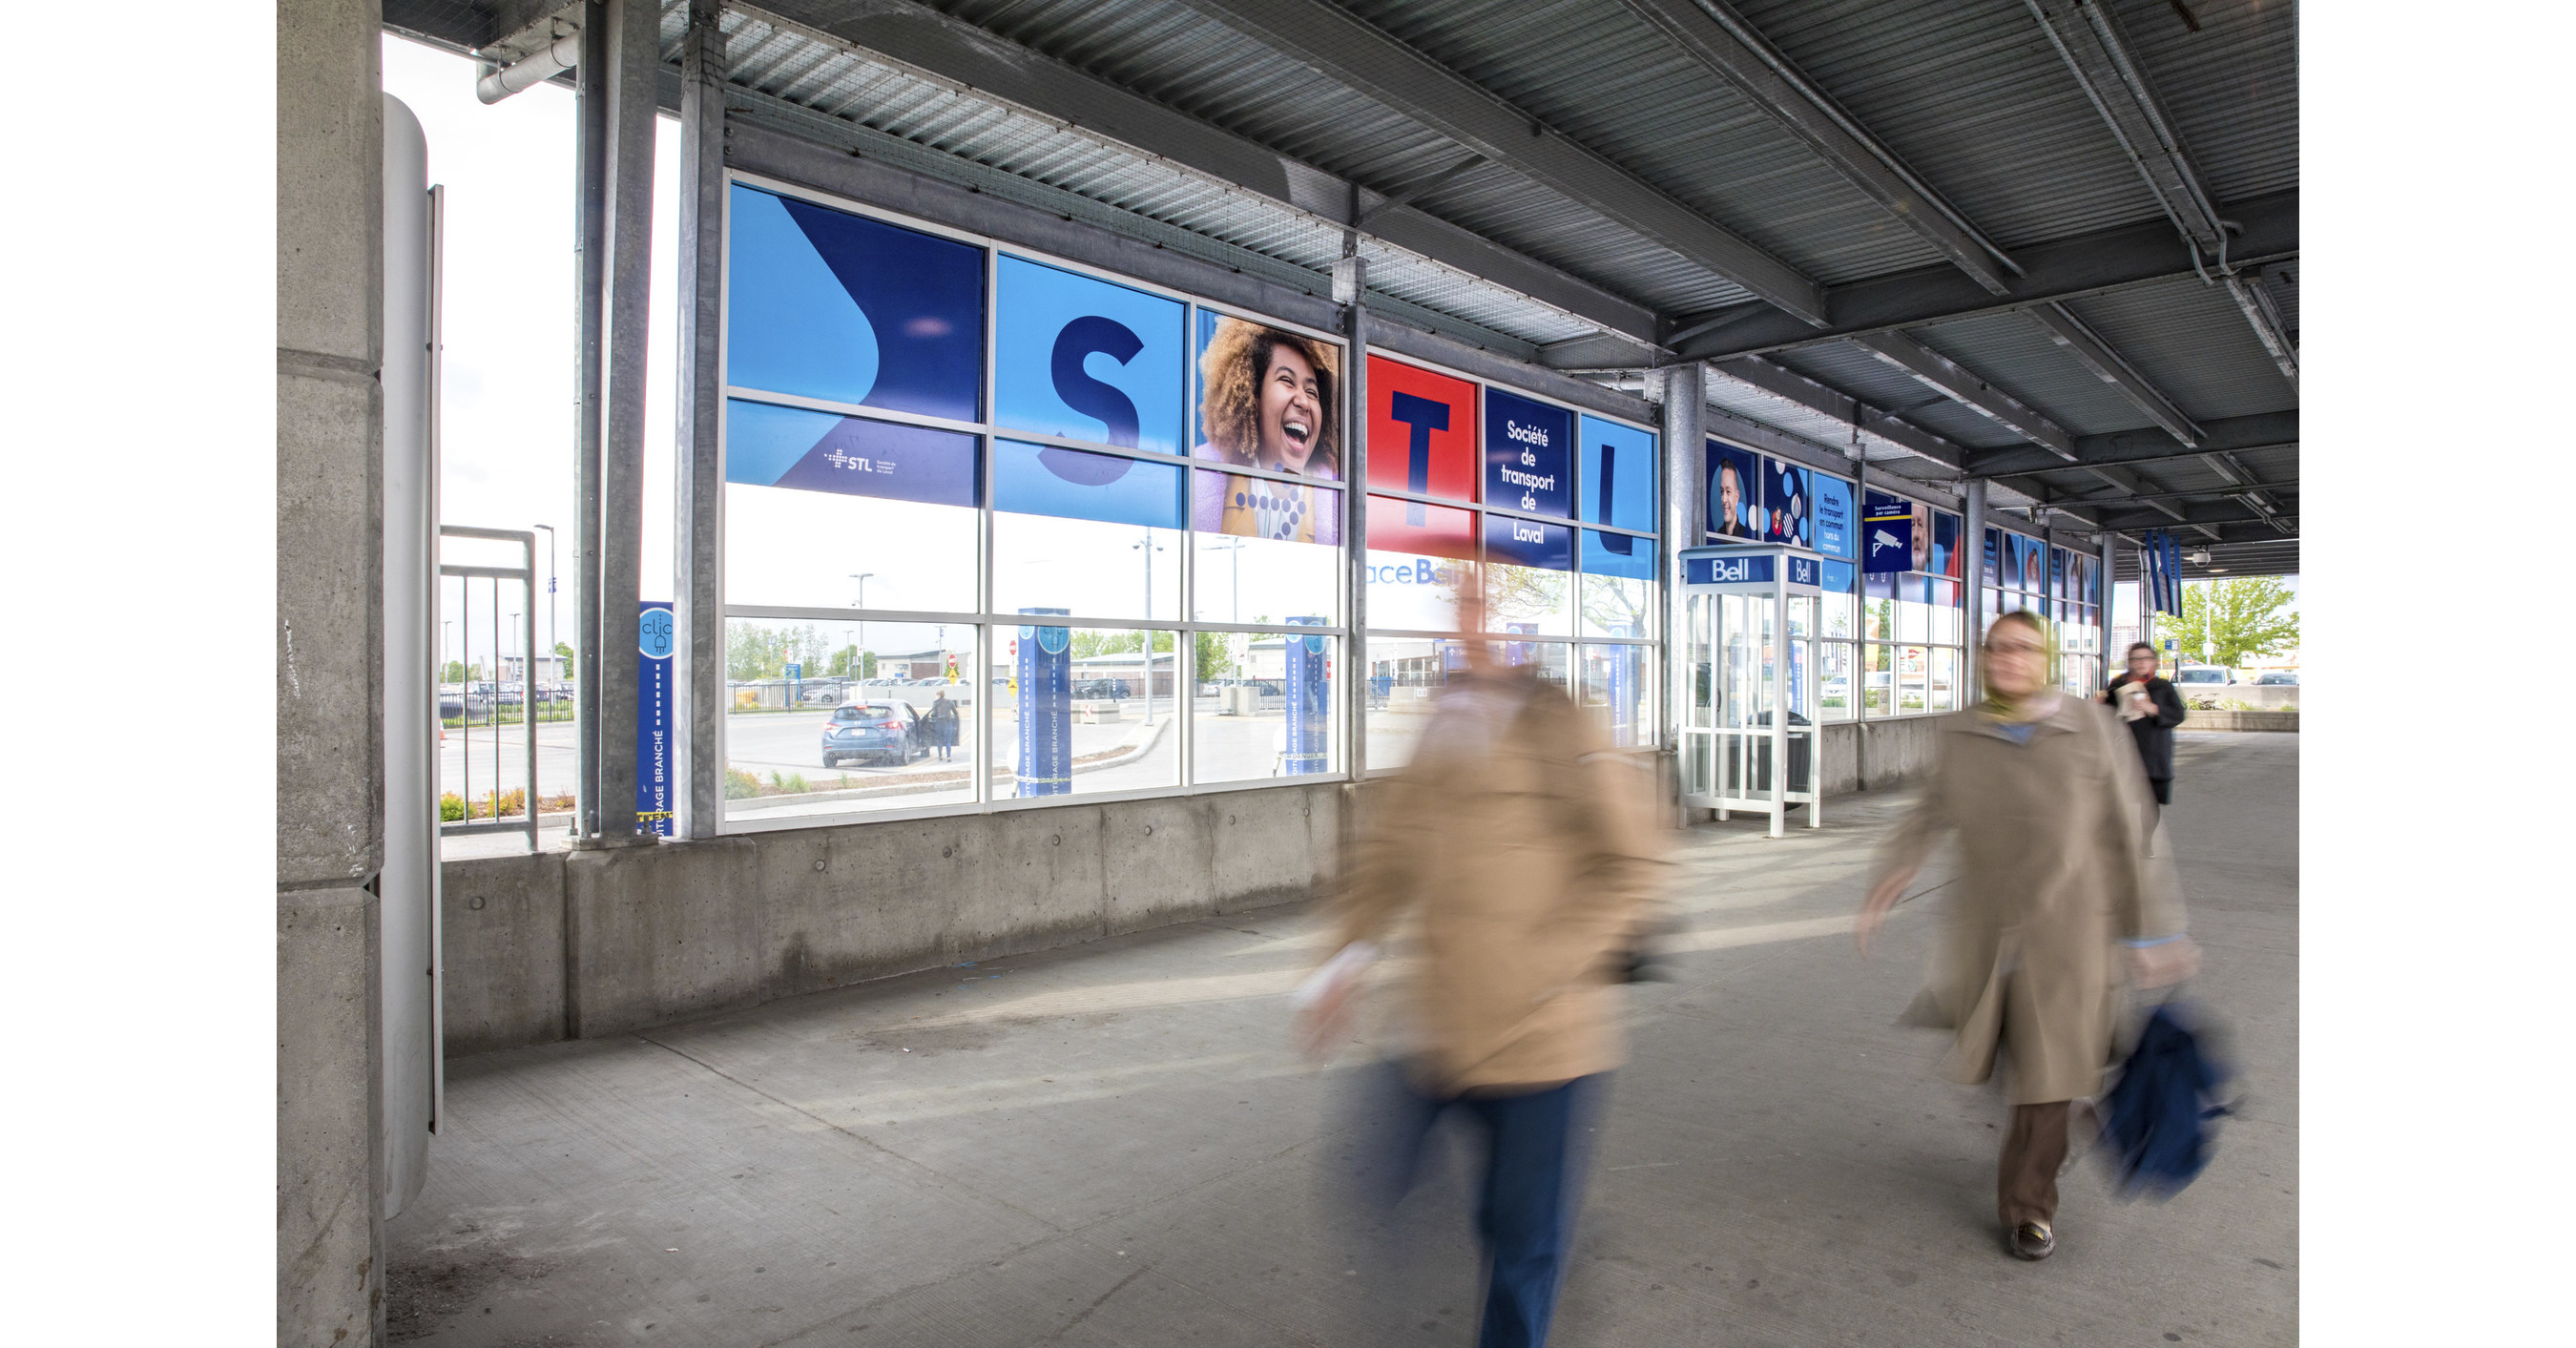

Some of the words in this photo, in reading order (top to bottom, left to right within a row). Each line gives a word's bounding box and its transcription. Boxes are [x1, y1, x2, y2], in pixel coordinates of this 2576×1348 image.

[1037, 316, 1144, 487] S
[1507, 420, 1548, 447] Société
[847, 457, 873, 472] STL
[1391, 390, 1450, 528] T
[1521, 446, 1536, 467] de
[1501, 464, 1554, 492] transport
[1521, 490, 1536, 510] de
[1599, 444, 1632, 556] L
[1513, 522, 1544, 544] Laval
[1713, 558, 1749, 582] Bell
[1797, 559, 1811, 583] Bell
[653, 730, 665, 782] BRANCHÉ
